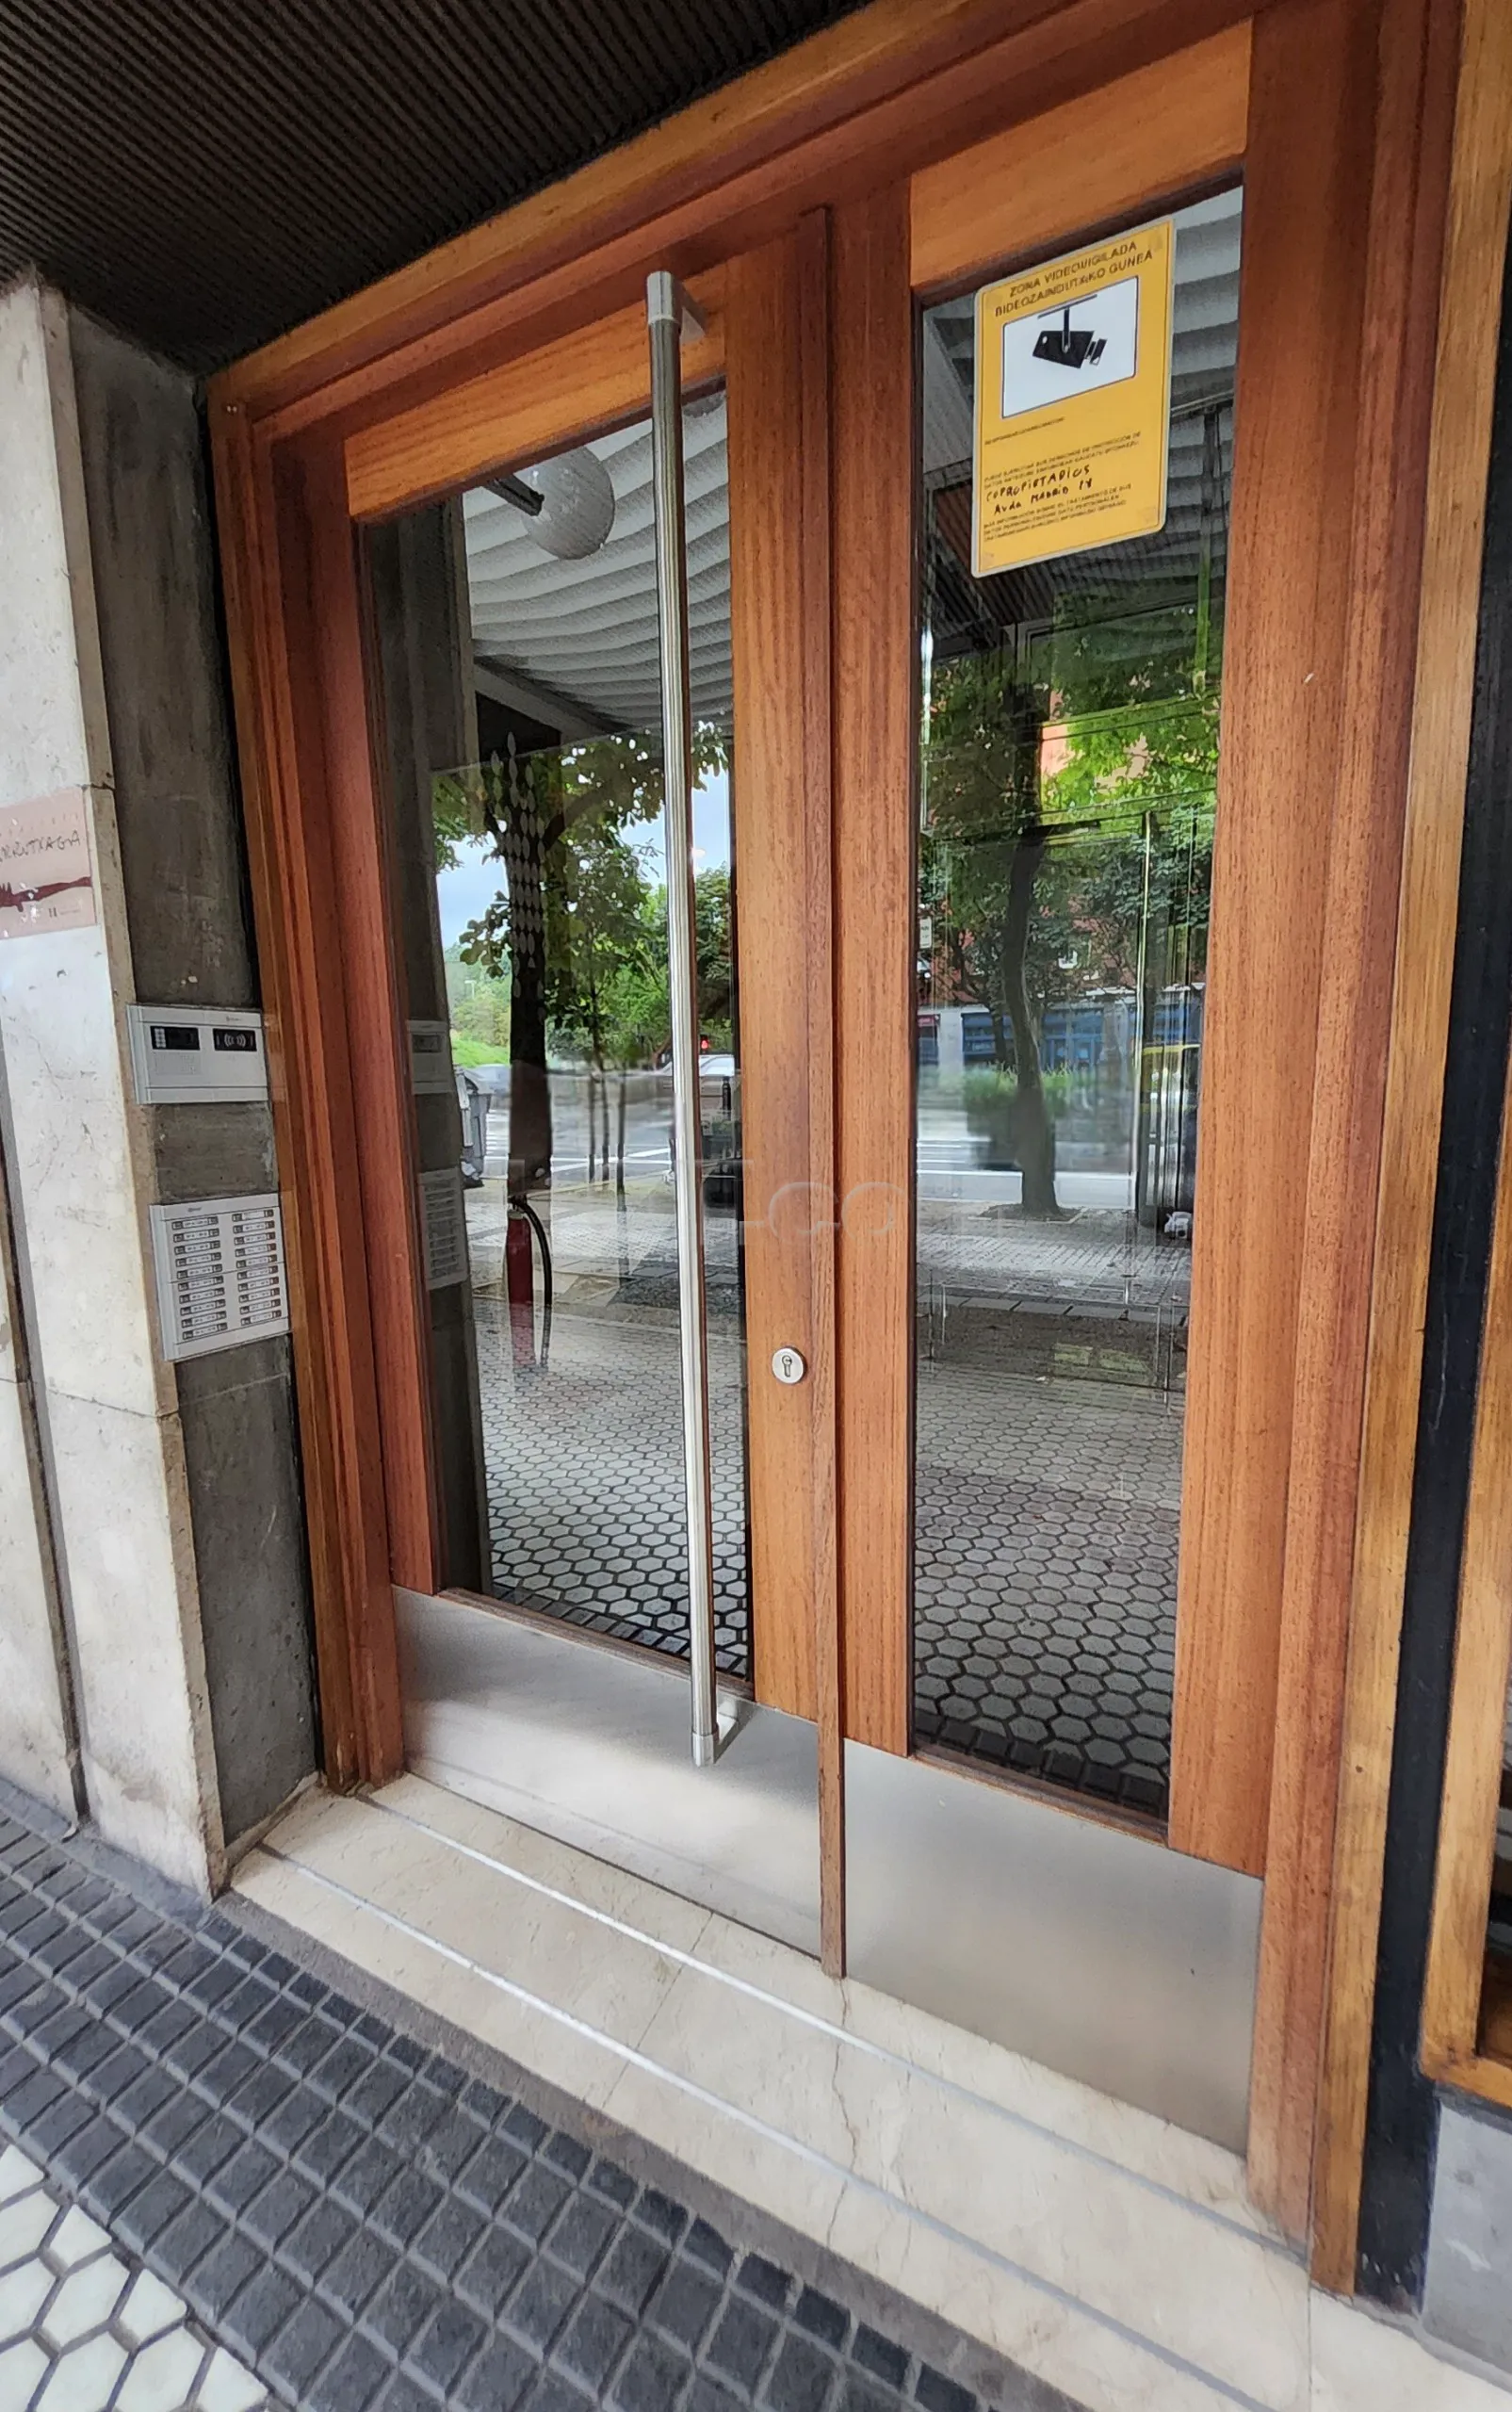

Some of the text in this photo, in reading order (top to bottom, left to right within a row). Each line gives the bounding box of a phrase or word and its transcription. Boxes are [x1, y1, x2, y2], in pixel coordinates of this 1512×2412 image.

[1009, 240, 1137, 298] ZONA VIDEOVIGILADA
[1109, 250, 1153, 274] GUNEA
